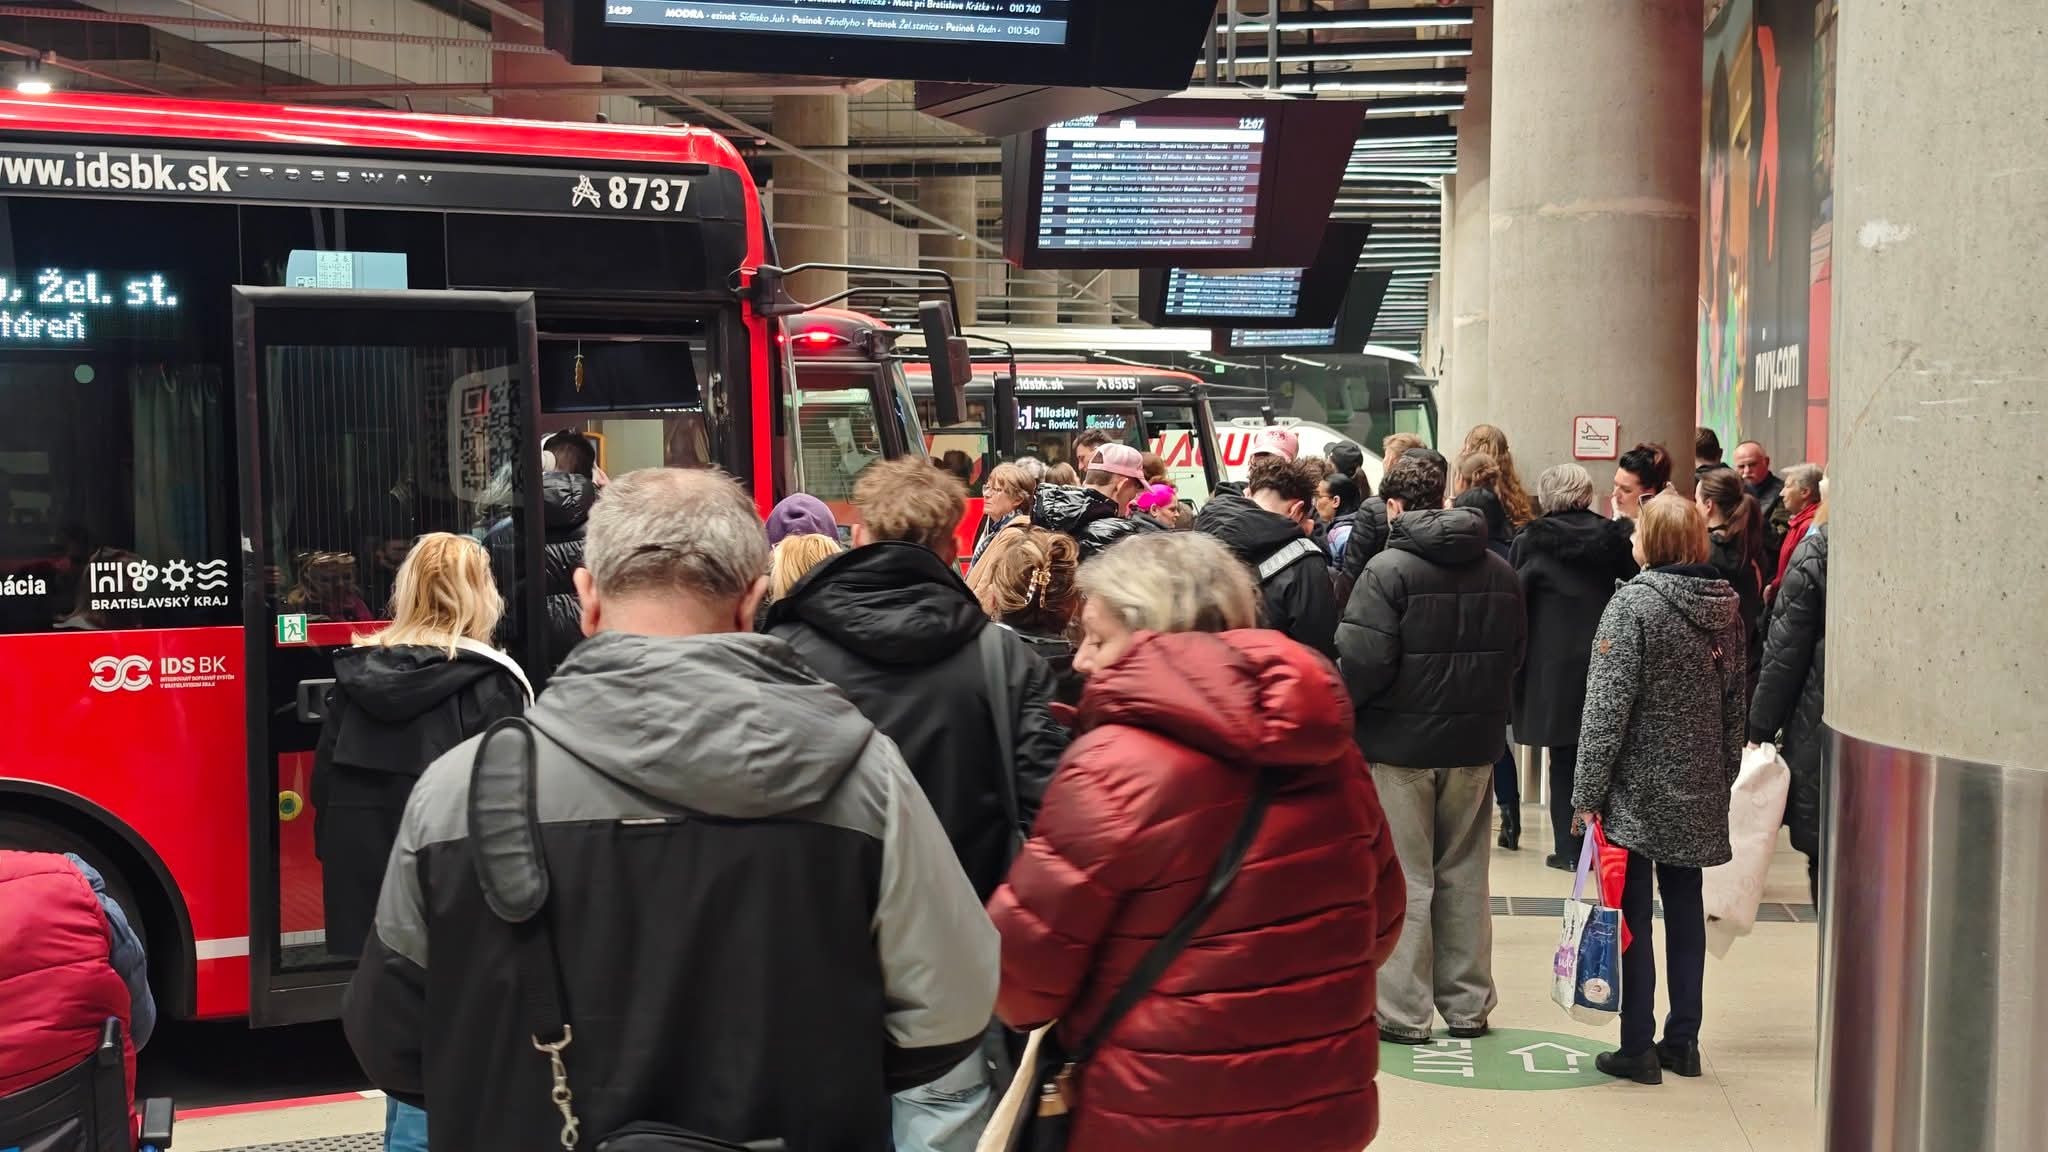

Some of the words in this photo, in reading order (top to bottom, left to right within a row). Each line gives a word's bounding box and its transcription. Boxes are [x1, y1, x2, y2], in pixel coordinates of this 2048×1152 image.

[1009, 4, 1025, 14] 010
[1026, 4, 1042, 15] 740
[665, 8, 704, 20] MODRA
[711, 12, 737, 22] ezinok
[770, 14, 785, 24] Juh
[792, 14, 823, 26] Pezinok
[824, 16, 861, 30] Fándlyho
[867, 18, 897, 29] Pezinok
[946, 22, 975, 33] Pezinok
[1007, 26, 1022, 36] 010
[1023, 27, 1040, 37] 540
[1238, 118, 1264, 130] 12:07
[236, 166, 432, 188] CROSSWAY
[608, 176, 690, 213] 8737
[38, 268, 112, 304] Žel.
[126, 274, 177, 306] st.
[1107, 376, 1136, 391] 8585
[1755, 328, 1799, 418] nivy.com
[1014, 377, 1064, 391] .idsbk.sk
[91, 594, 191, 610] BRATISLAVSKÝ
[194, 595, 229, 608] KRAJ
[160, 656, 195, 675] IDS
[199, 655, 227, 674] BK
[1412, 1039, 1474, 1078] EXIT
